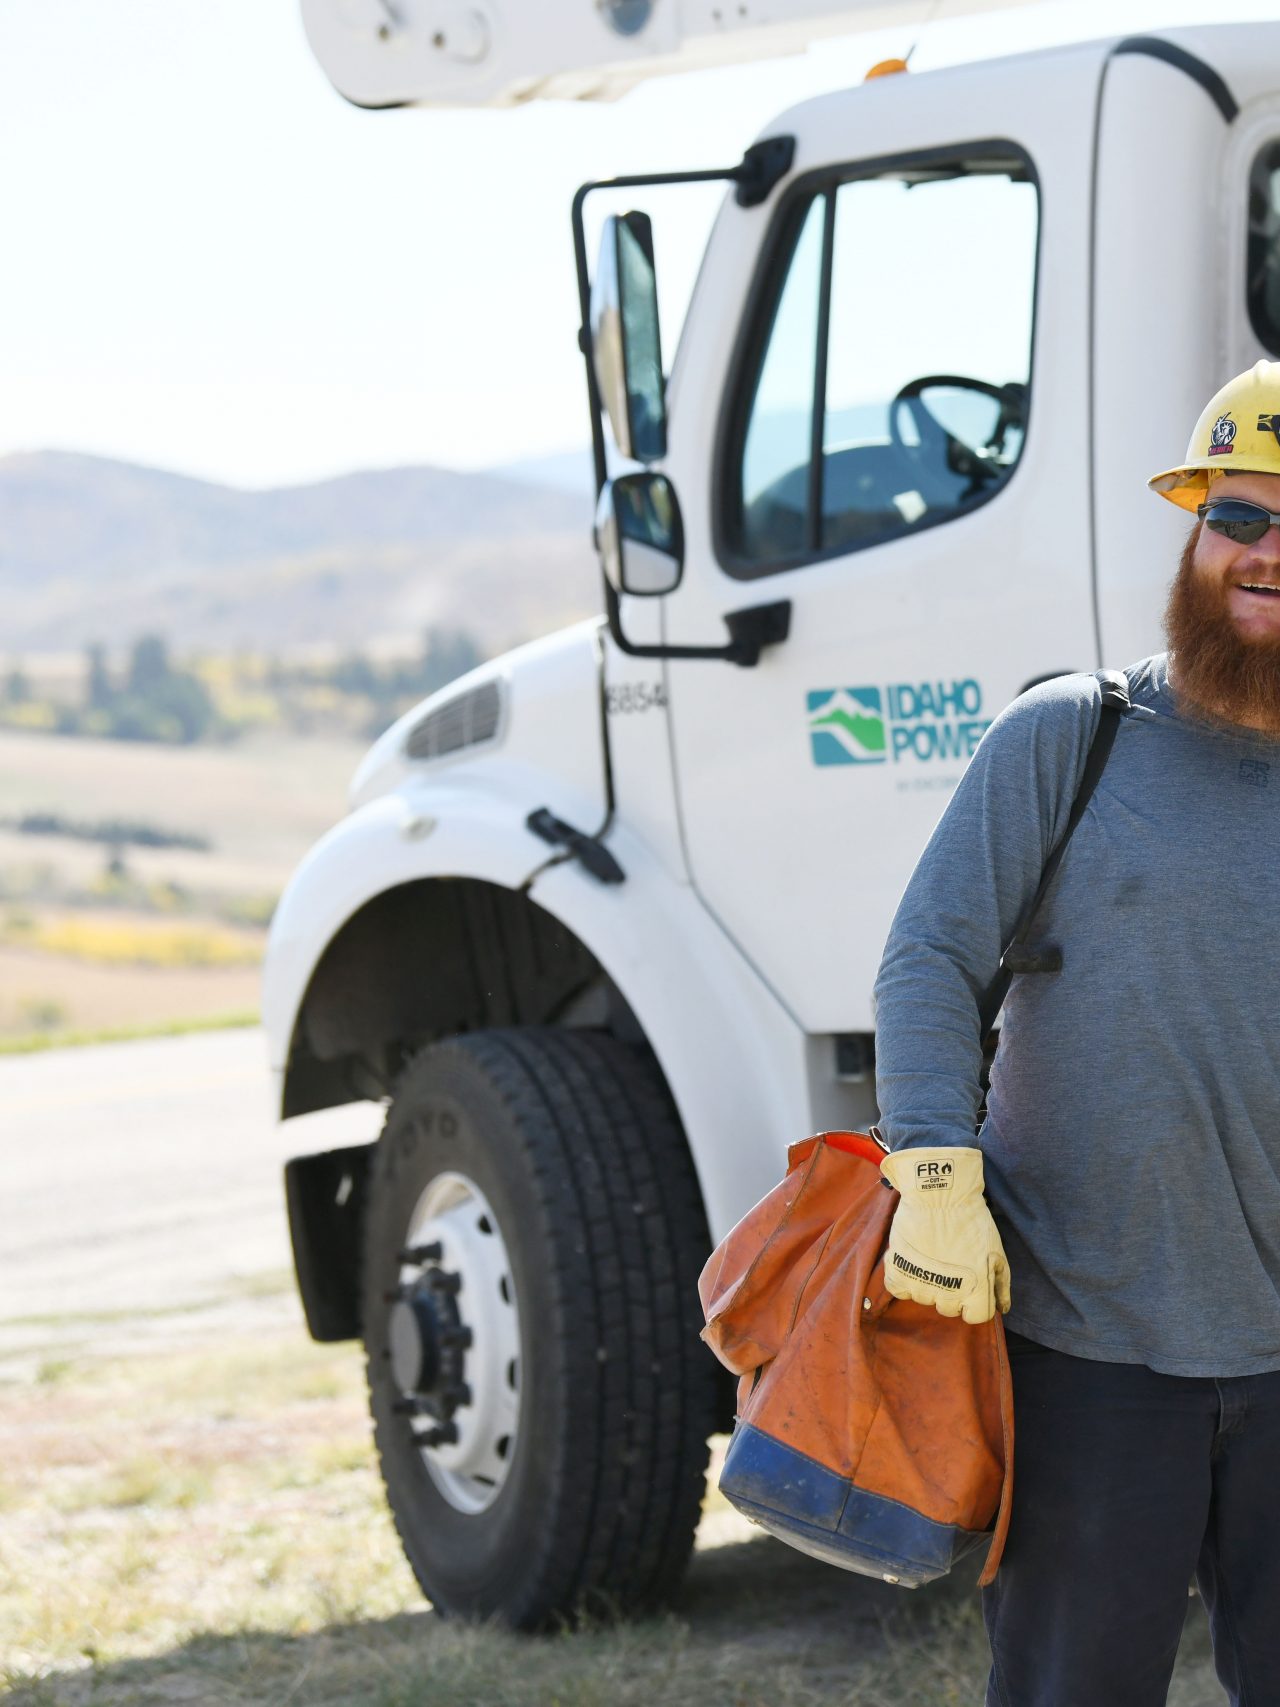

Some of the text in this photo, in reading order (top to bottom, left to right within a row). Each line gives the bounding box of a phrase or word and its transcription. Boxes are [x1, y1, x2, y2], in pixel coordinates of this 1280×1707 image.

[887, 678, 982, 720] IDAHO
[891, 720, 992, 763] POWE
[917, 1162, 939, 1176] FR
[921, 1182, 948, 1190] RESISTANT
[893, 1252, 964, 1289] YOUNGSTOWN
